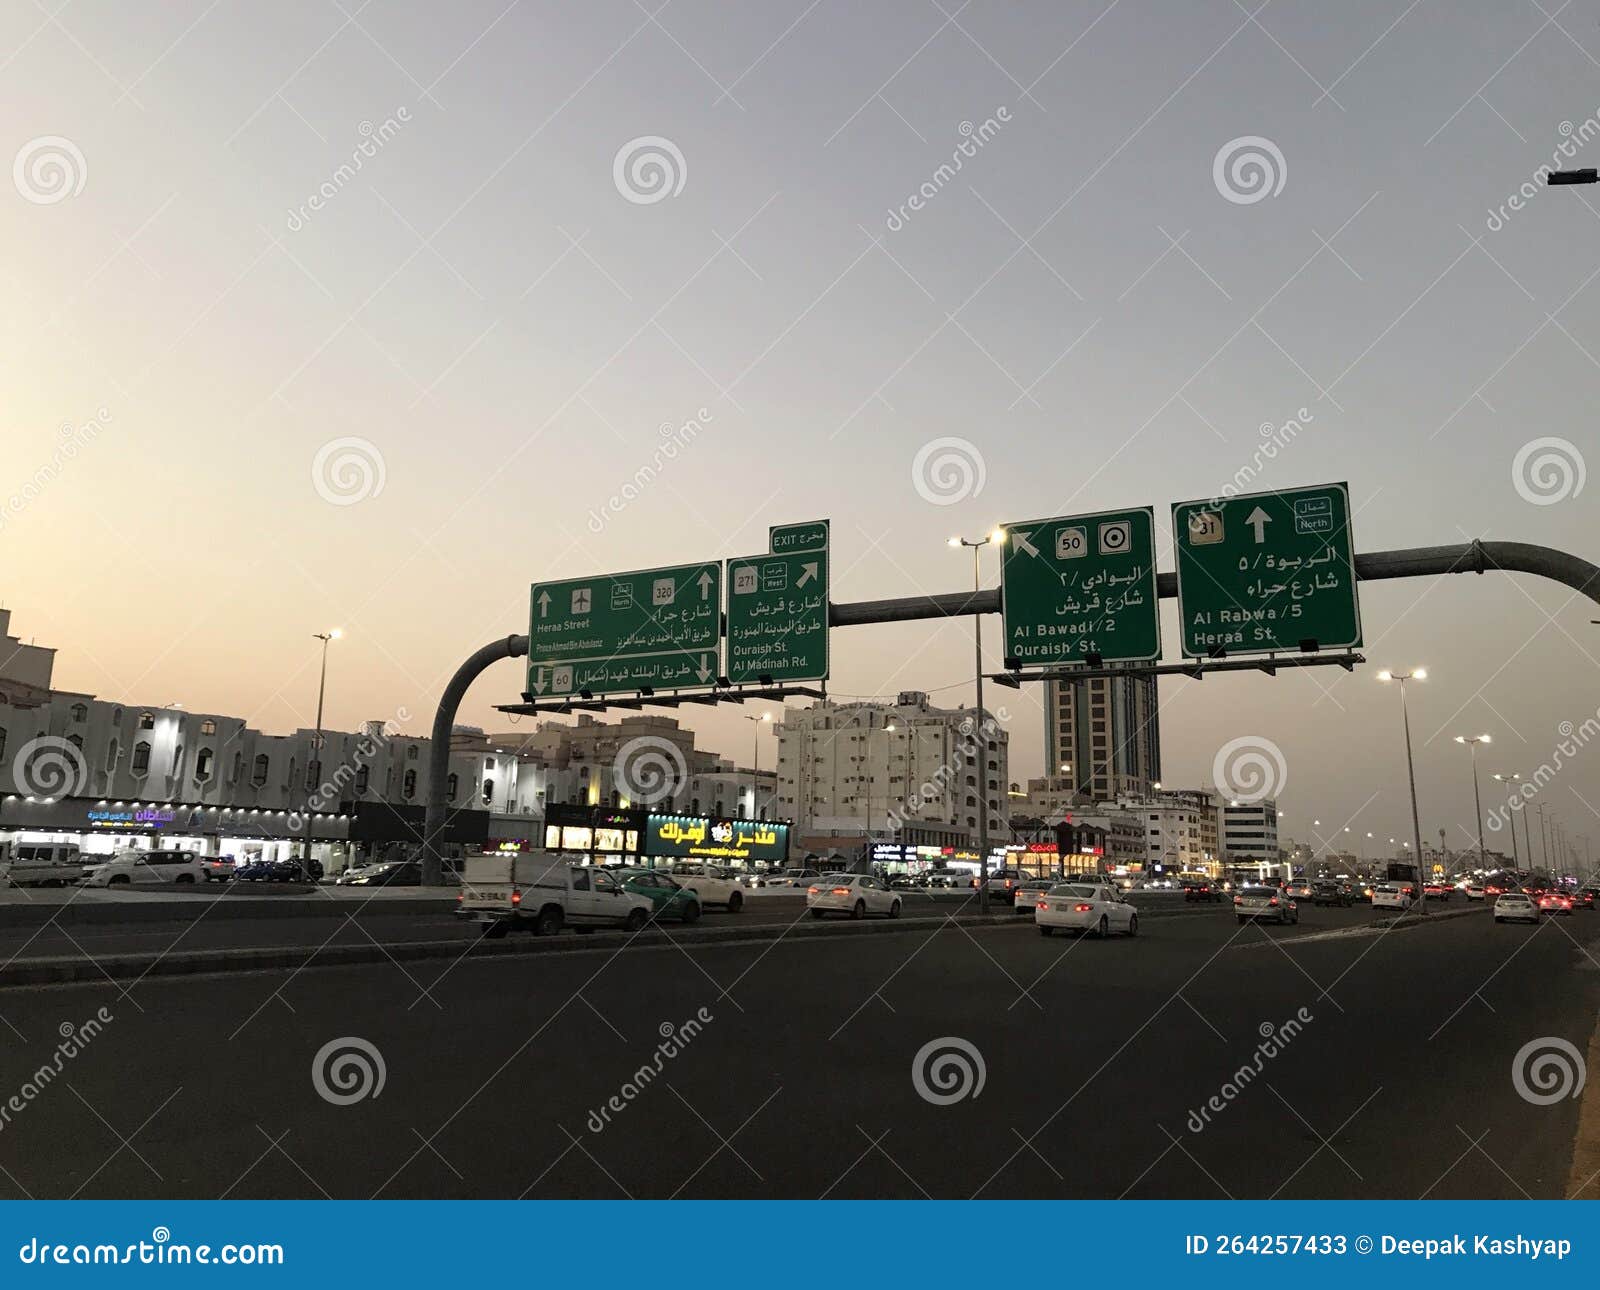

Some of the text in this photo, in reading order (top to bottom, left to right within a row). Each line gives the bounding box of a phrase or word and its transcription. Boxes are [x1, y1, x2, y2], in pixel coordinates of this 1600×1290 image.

[1200, 522, 1214, 534] 31
[1300, 519, 1328, 530] North
[774, 532, 824, 546] EXIT مخرج
[1062, 537, 1080, 550] 50
[738, 575, 754, 587] 271
[1247, 572, 1339, 599] شارع حراء
[656, 587, 672, 599] 320
[749, 595, 821, 616] شارع قريش
[1056, 590, 1143, 615] شارع قريش
[681, 604, 711, 622] شارع
[1194, 612, 1211, 625] Al
[537, 619, 590, 633] Heraa Street
[733, 618, 821, 639] طريق المدينة المنورة
[1014, 626, 1029, 638] Al
[692, 626, 711, 642] طريق
[1194, 627, 1277, 645] Heraa St.
[733, 644, 772, 656] Quraish
[1014, 640, 1101, 656] Quraish St.
[661, 662, 690, 679] طريق
[733, 655, 808, 672] Al Madinah Rd.
[610, 667, 629, 682] فهد
[631, 664, 660, 678] الملك
[556, 674, 569, 685] 60
